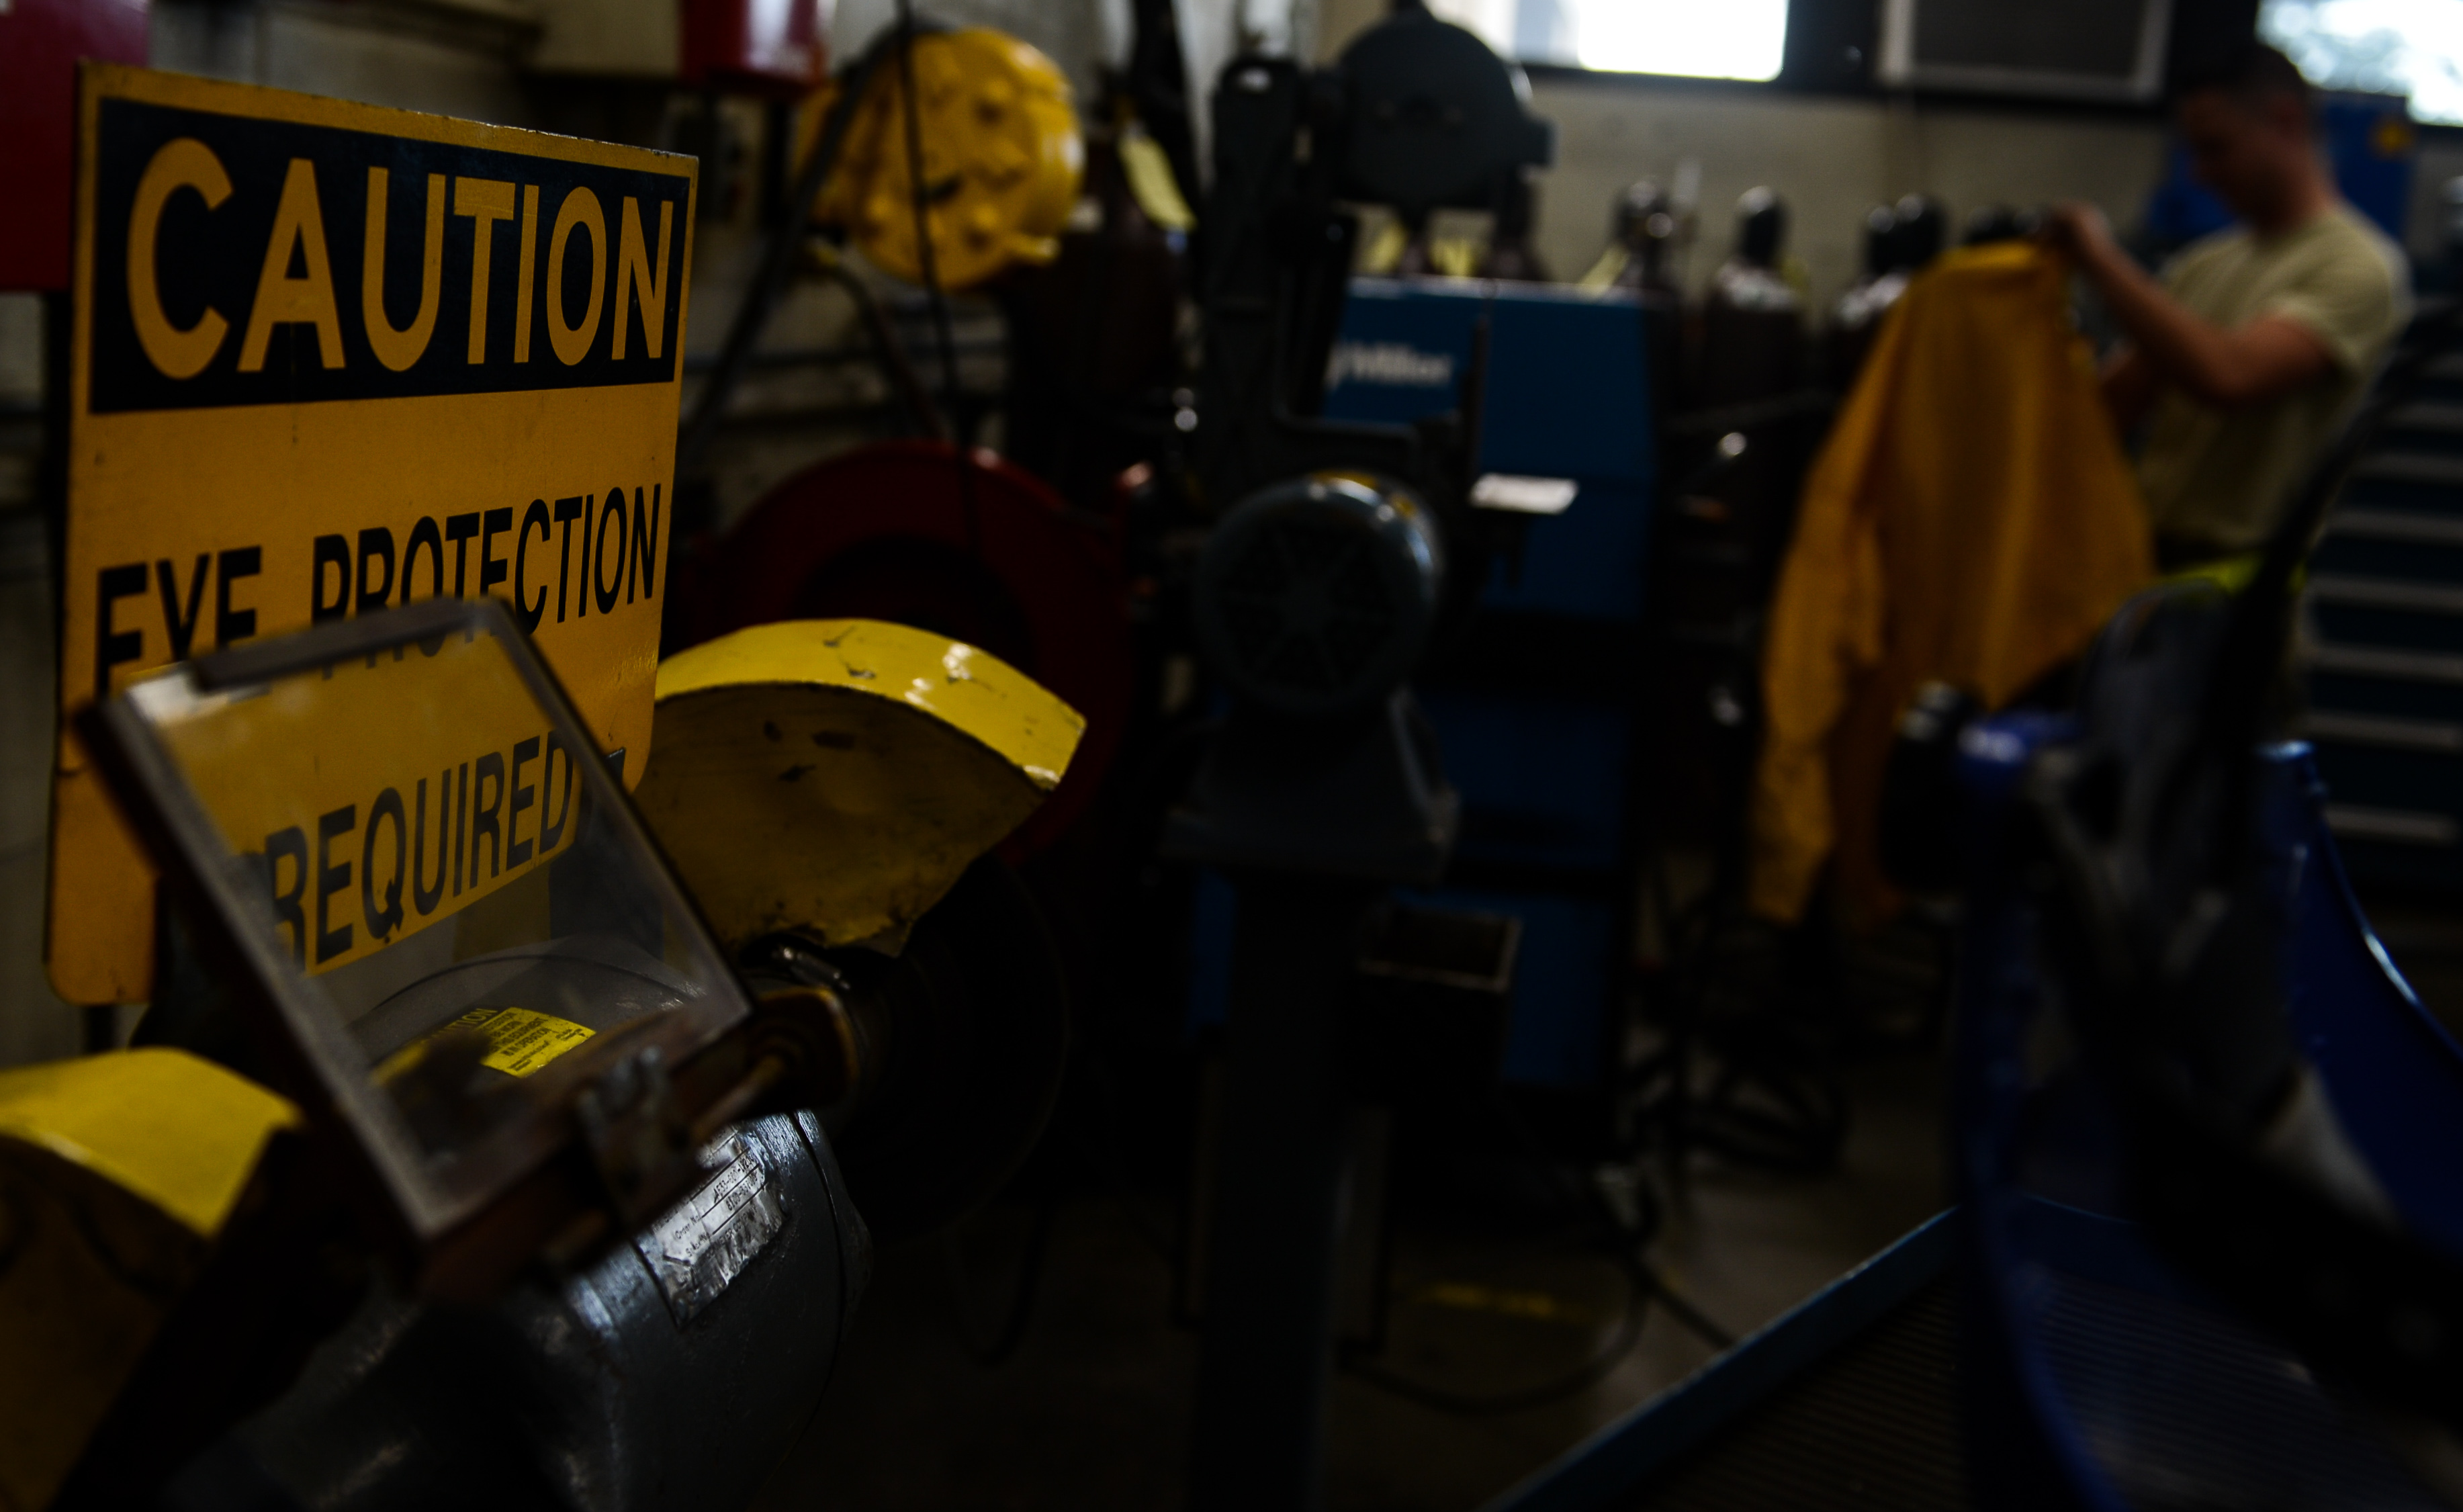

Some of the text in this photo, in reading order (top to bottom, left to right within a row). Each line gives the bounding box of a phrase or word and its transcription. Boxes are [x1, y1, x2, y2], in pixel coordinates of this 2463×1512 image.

[126, 135, 674, 382] CAUTION
[97, 484, 662, 692] EYE PROTECTION
[265, 729, 582, 971] REQUIRED
